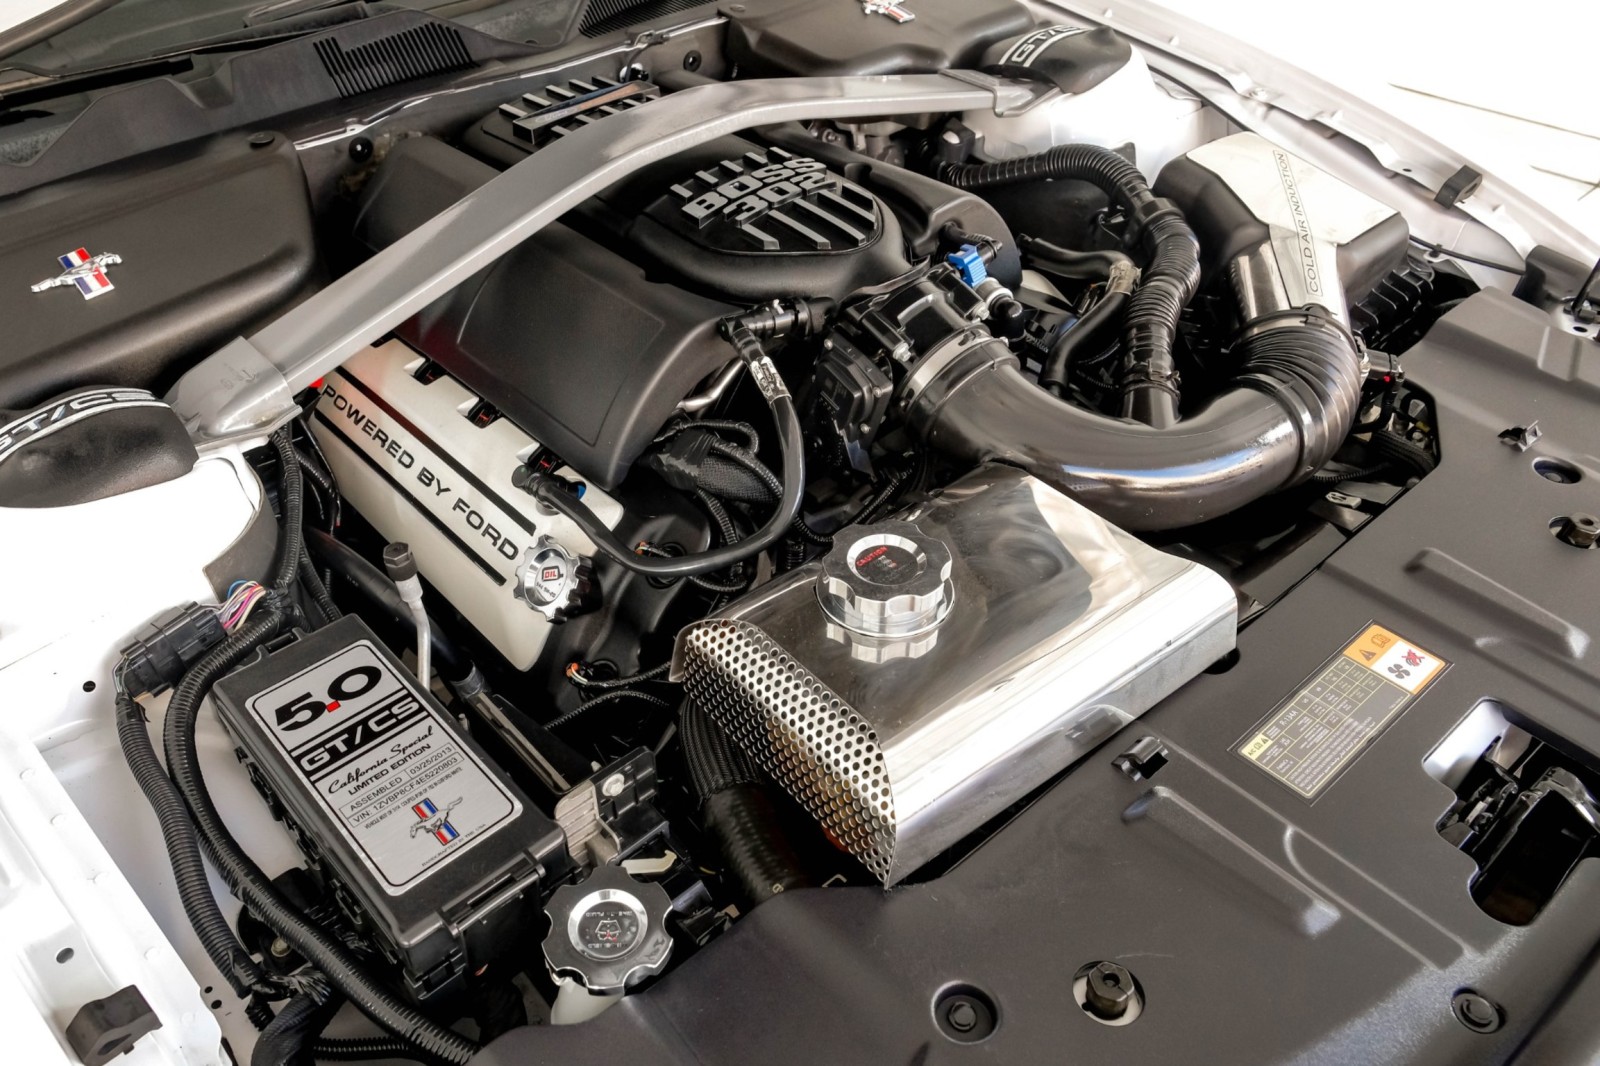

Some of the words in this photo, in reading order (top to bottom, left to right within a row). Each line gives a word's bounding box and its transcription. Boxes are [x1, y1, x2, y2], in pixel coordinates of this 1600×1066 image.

[682, 158, 827, 225] BOSS
[723, 172, 837, 227] 302
[1277, 153, 1303, 217] INDUCTION
[1299, 219, 1313, 244] AIR
[1303, 247, 1319, 293] COLD
[322, 384, 415, 469] POWERED
[417, 466, 451, 497] BY
[452, 497, 519, 561] FORD
[544, 570, 557, 579] OIL
[856, 546, 888, 567] CAUTION
[274, 665, 382, 731] 5.0
[300, 700, 420, 772] GT/CS
[328, 757, 388, 794] California
[389, 726, 433, 759] Special
[348, 769, 389, 795] LIMITED
[390, 743, 431, 770] EDITION
[350, 777, 403, 812] ASSEMBLED
[410, 747, 453, 775] 03/25/2013
[353, 809, 373, 823] VIN:
